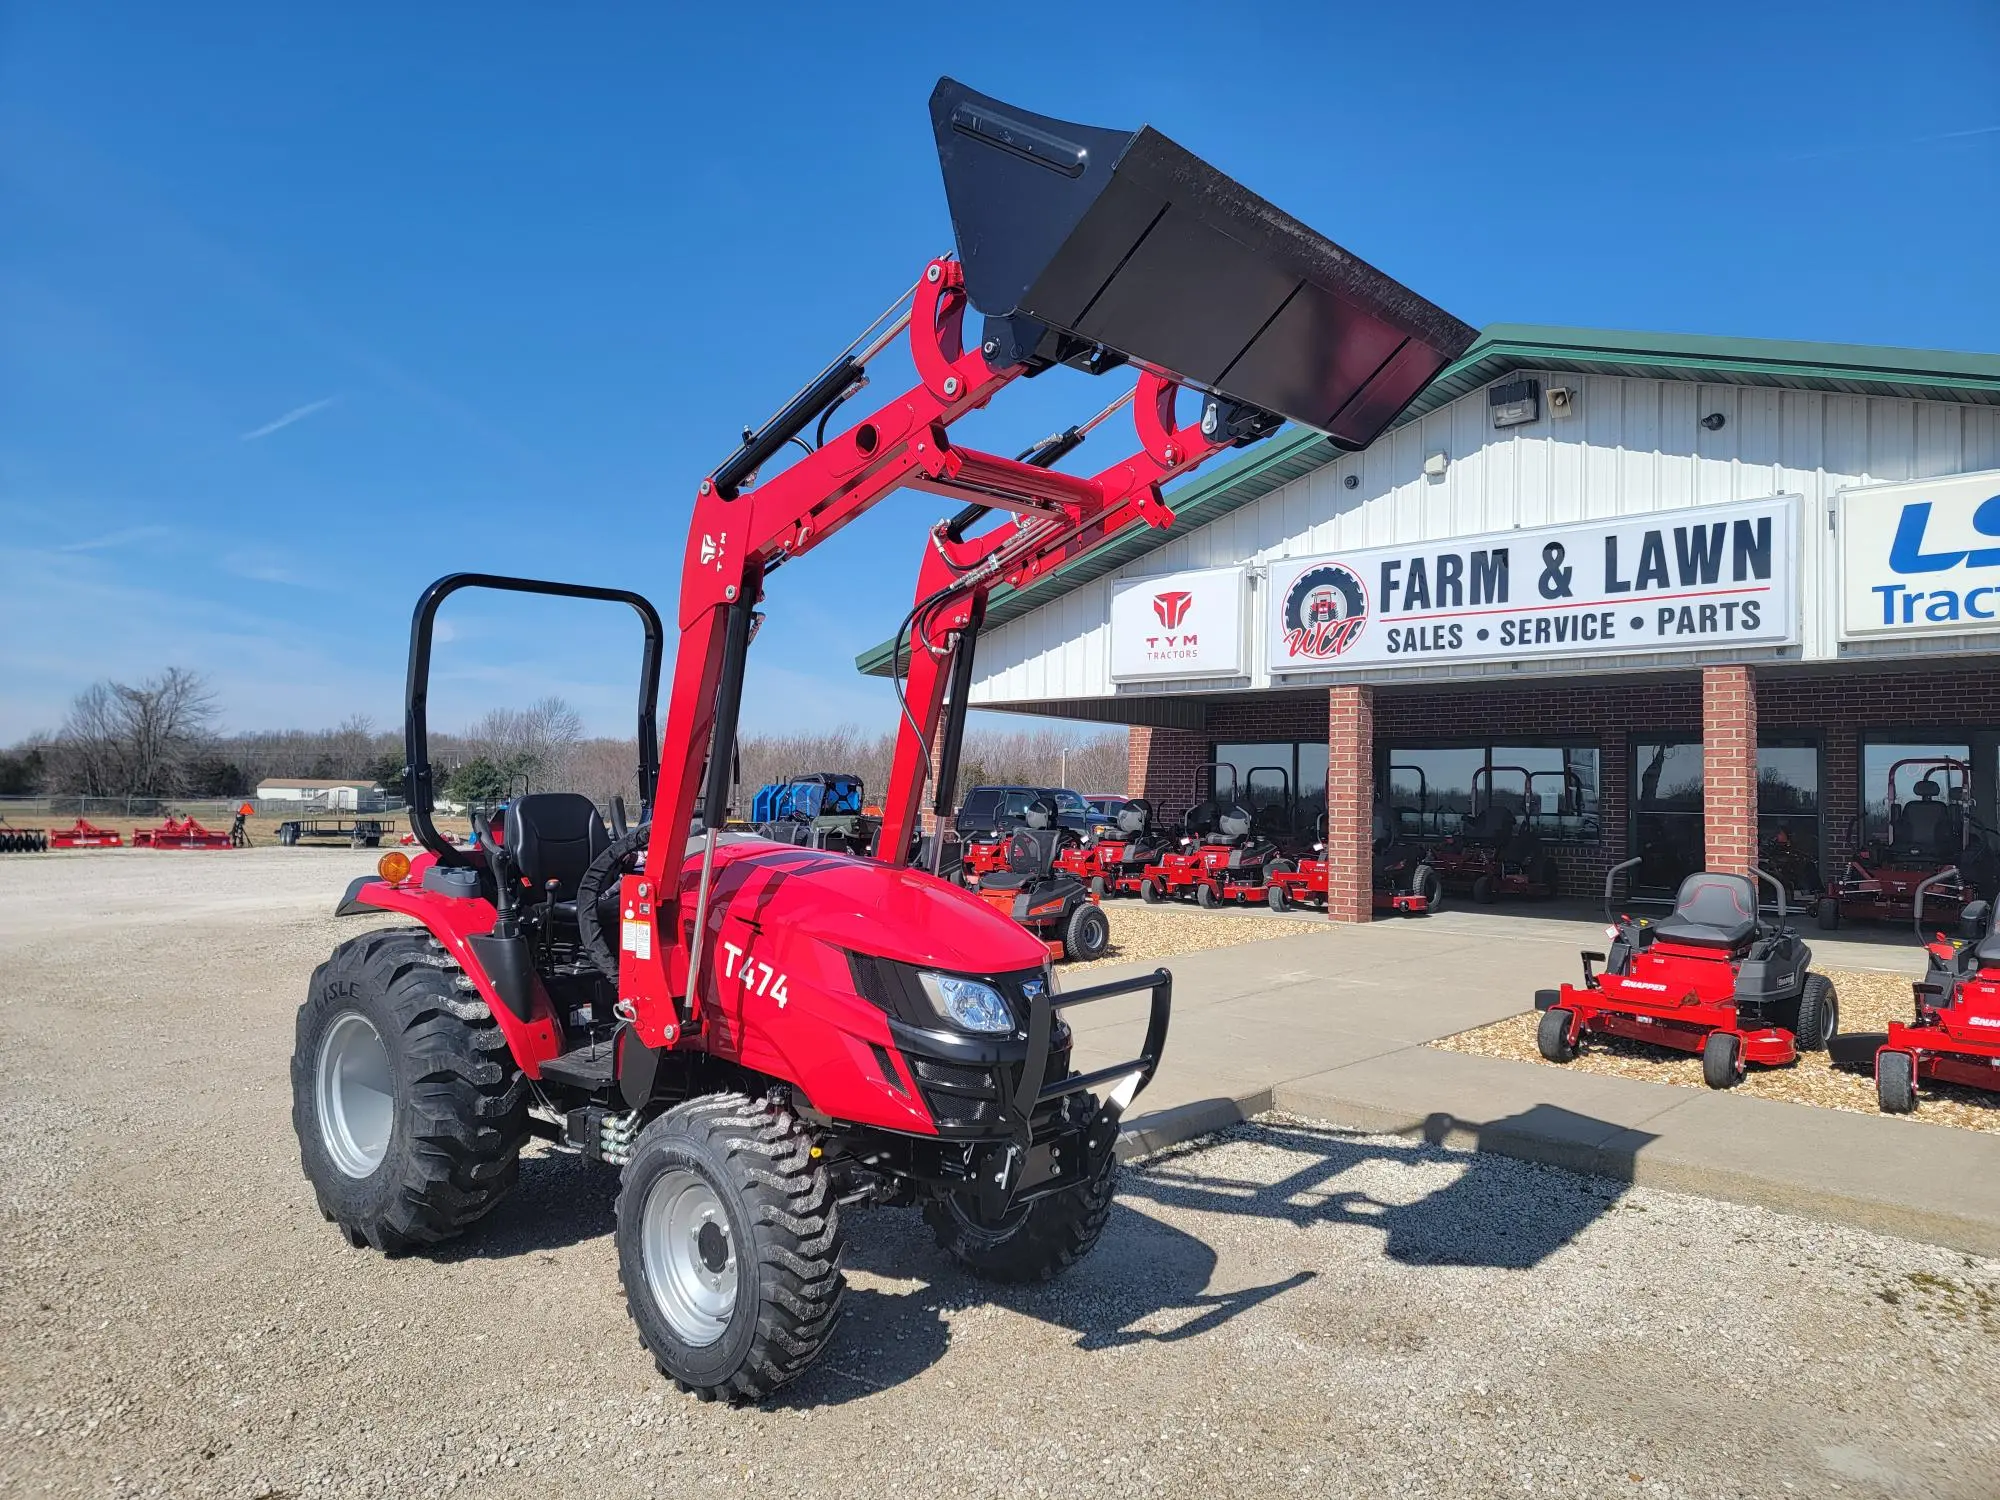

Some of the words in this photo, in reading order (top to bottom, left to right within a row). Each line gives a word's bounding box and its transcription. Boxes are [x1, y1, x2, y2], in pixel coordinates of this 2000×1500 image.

[716, 532, 727, 573] TYM
[1380, 548, 1509, 613] FARM
[1538, 541, 1574, 600] &
[1605, 517, 1771, 594] LAWN
[1872, 584, 2000, 625] Trac
[1145, 634, 1198, 649] TYM
[1283, 616, 1367, 657] WCT
[1387, 623, 1463, 654] SALES
[1500, 611, 1616, 647] SERVICE
[1658, 600, 1761, 637] PARTS
[1147, 649, 1198, 661] TRACTORS
[724, 941, 788, 1009] T474
[1621, 980, 1668, 992] SNAPPER
